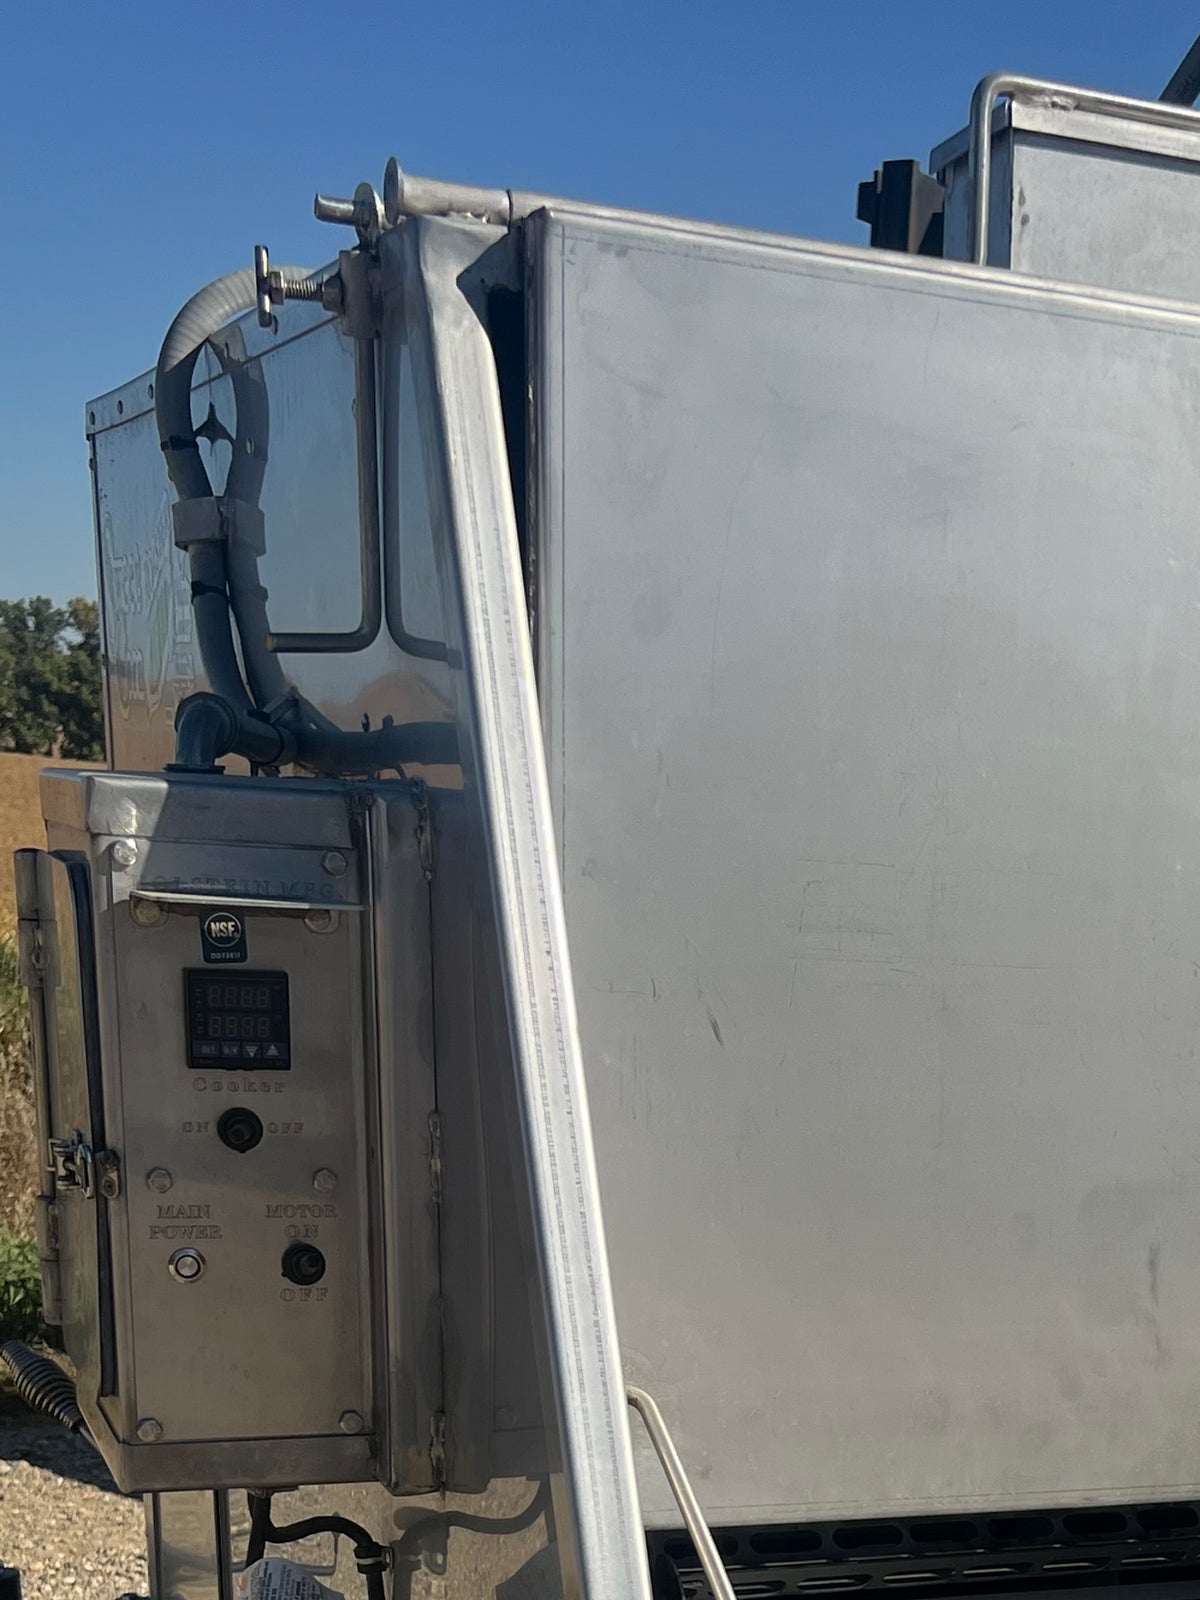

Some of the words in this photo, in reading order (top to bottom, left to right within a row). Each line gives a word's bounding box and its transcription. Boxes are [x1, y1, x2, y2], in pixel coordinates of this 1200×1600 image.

[210, 921, 235, 938] NSF
[193, 1076, 286, 1093] Cooker
[182, 1121, 209, 1133] ON
[267, 1122, 304, 1134] OFF
[157, 1204, 211, 1219] MAIN
[265, 1204, 337, 1218] MOTOR
[149, 1225, 223, 1240] POWER
[284, 1224, 319, 1239] ON
[280, 1287, 329, 1303] OFF
